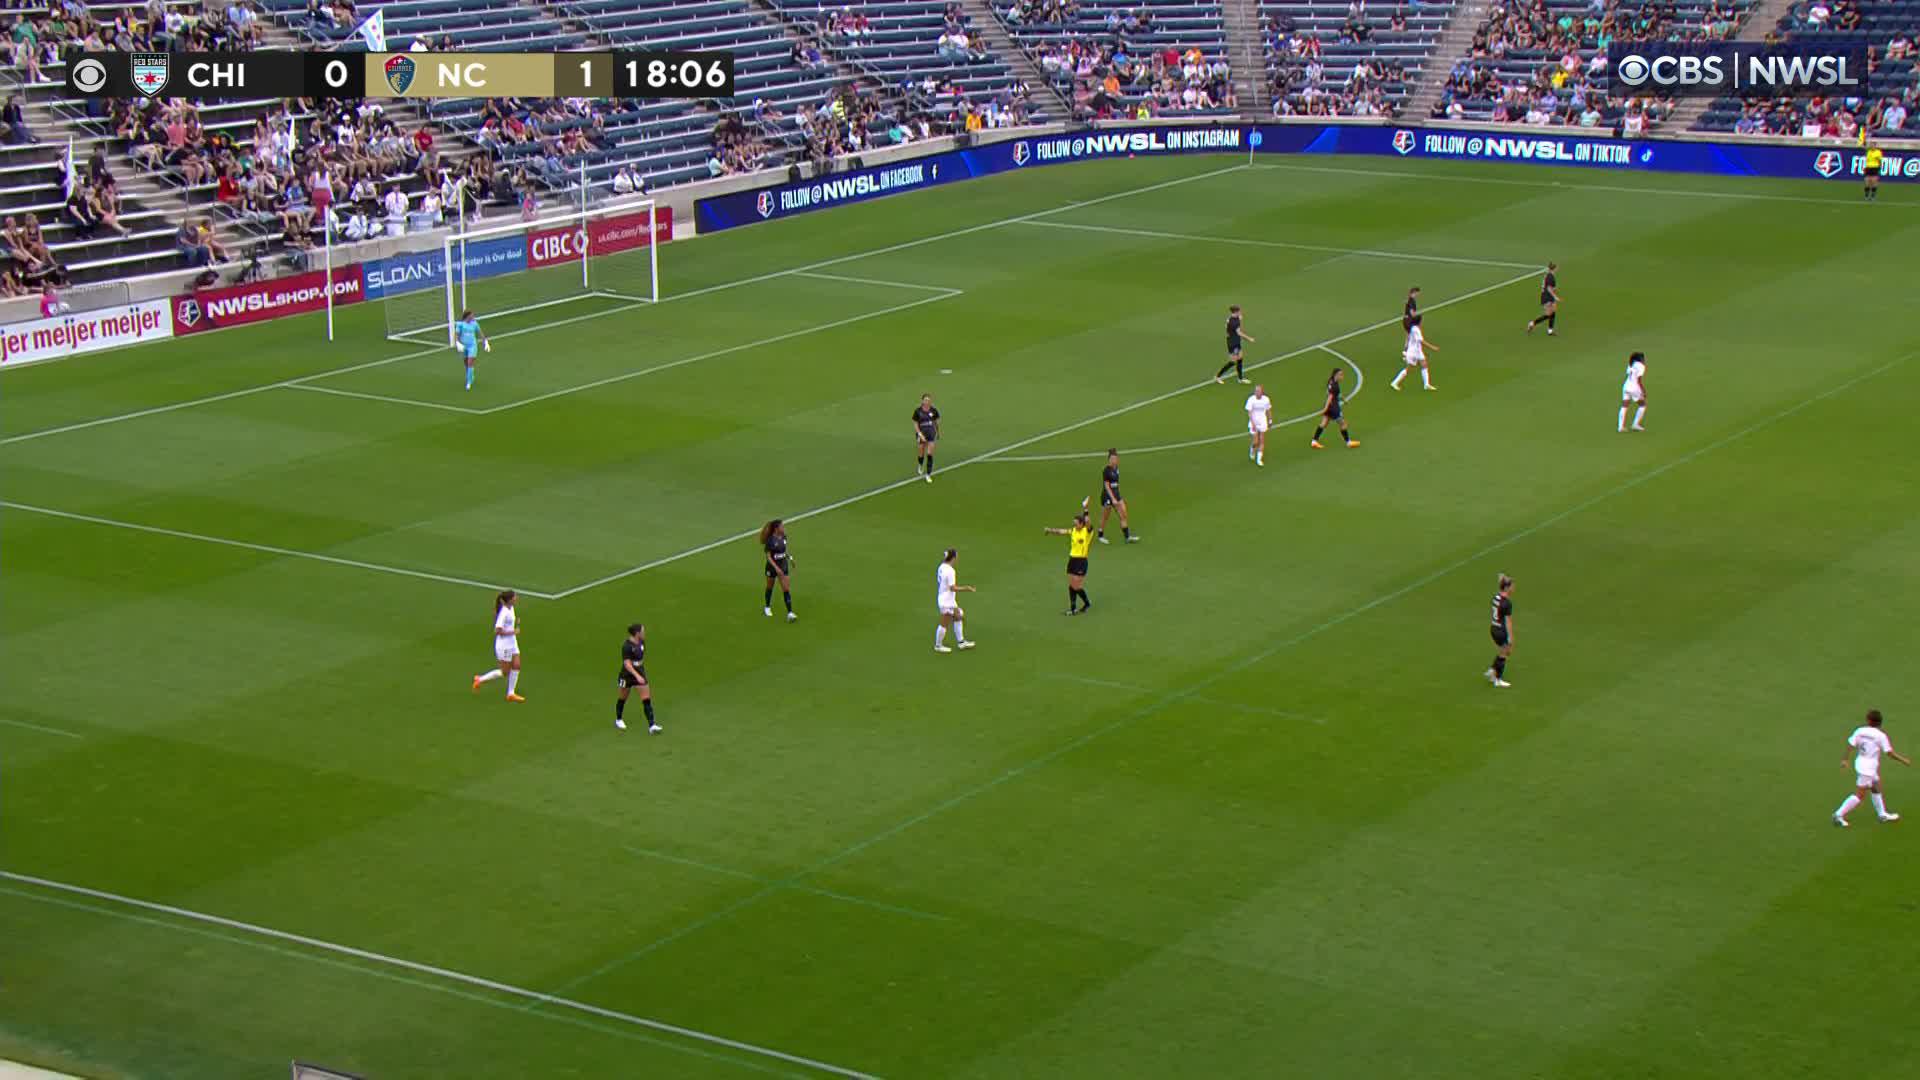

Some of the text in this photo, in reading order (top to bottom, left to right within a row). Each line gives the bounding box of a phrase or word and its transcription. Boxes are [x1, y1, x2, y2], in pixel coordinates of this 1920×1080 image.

[1037, 141, 1071, 159] FOLLOW
[1167, 132, 1182, 148] ON
[1182, 129, 1240, 148] INSTAGRAM
[1425, 135, 1467, 154] FOLLOW
[1575, 143, 1591, 161] ON
[1592, 144, 1632, 164] TIKTOK
[780, 187, 811, 210] FOLLOW
[880, 174, 890, 189] ON
[890, 165, 924, 187] FACEBOOK
[532, 234, 572, 261] CIBC
[367, 261, 432, 289] SLOAN
[32, 317, 97, 349] meijer
[101, 306, 161, 337] meijer
